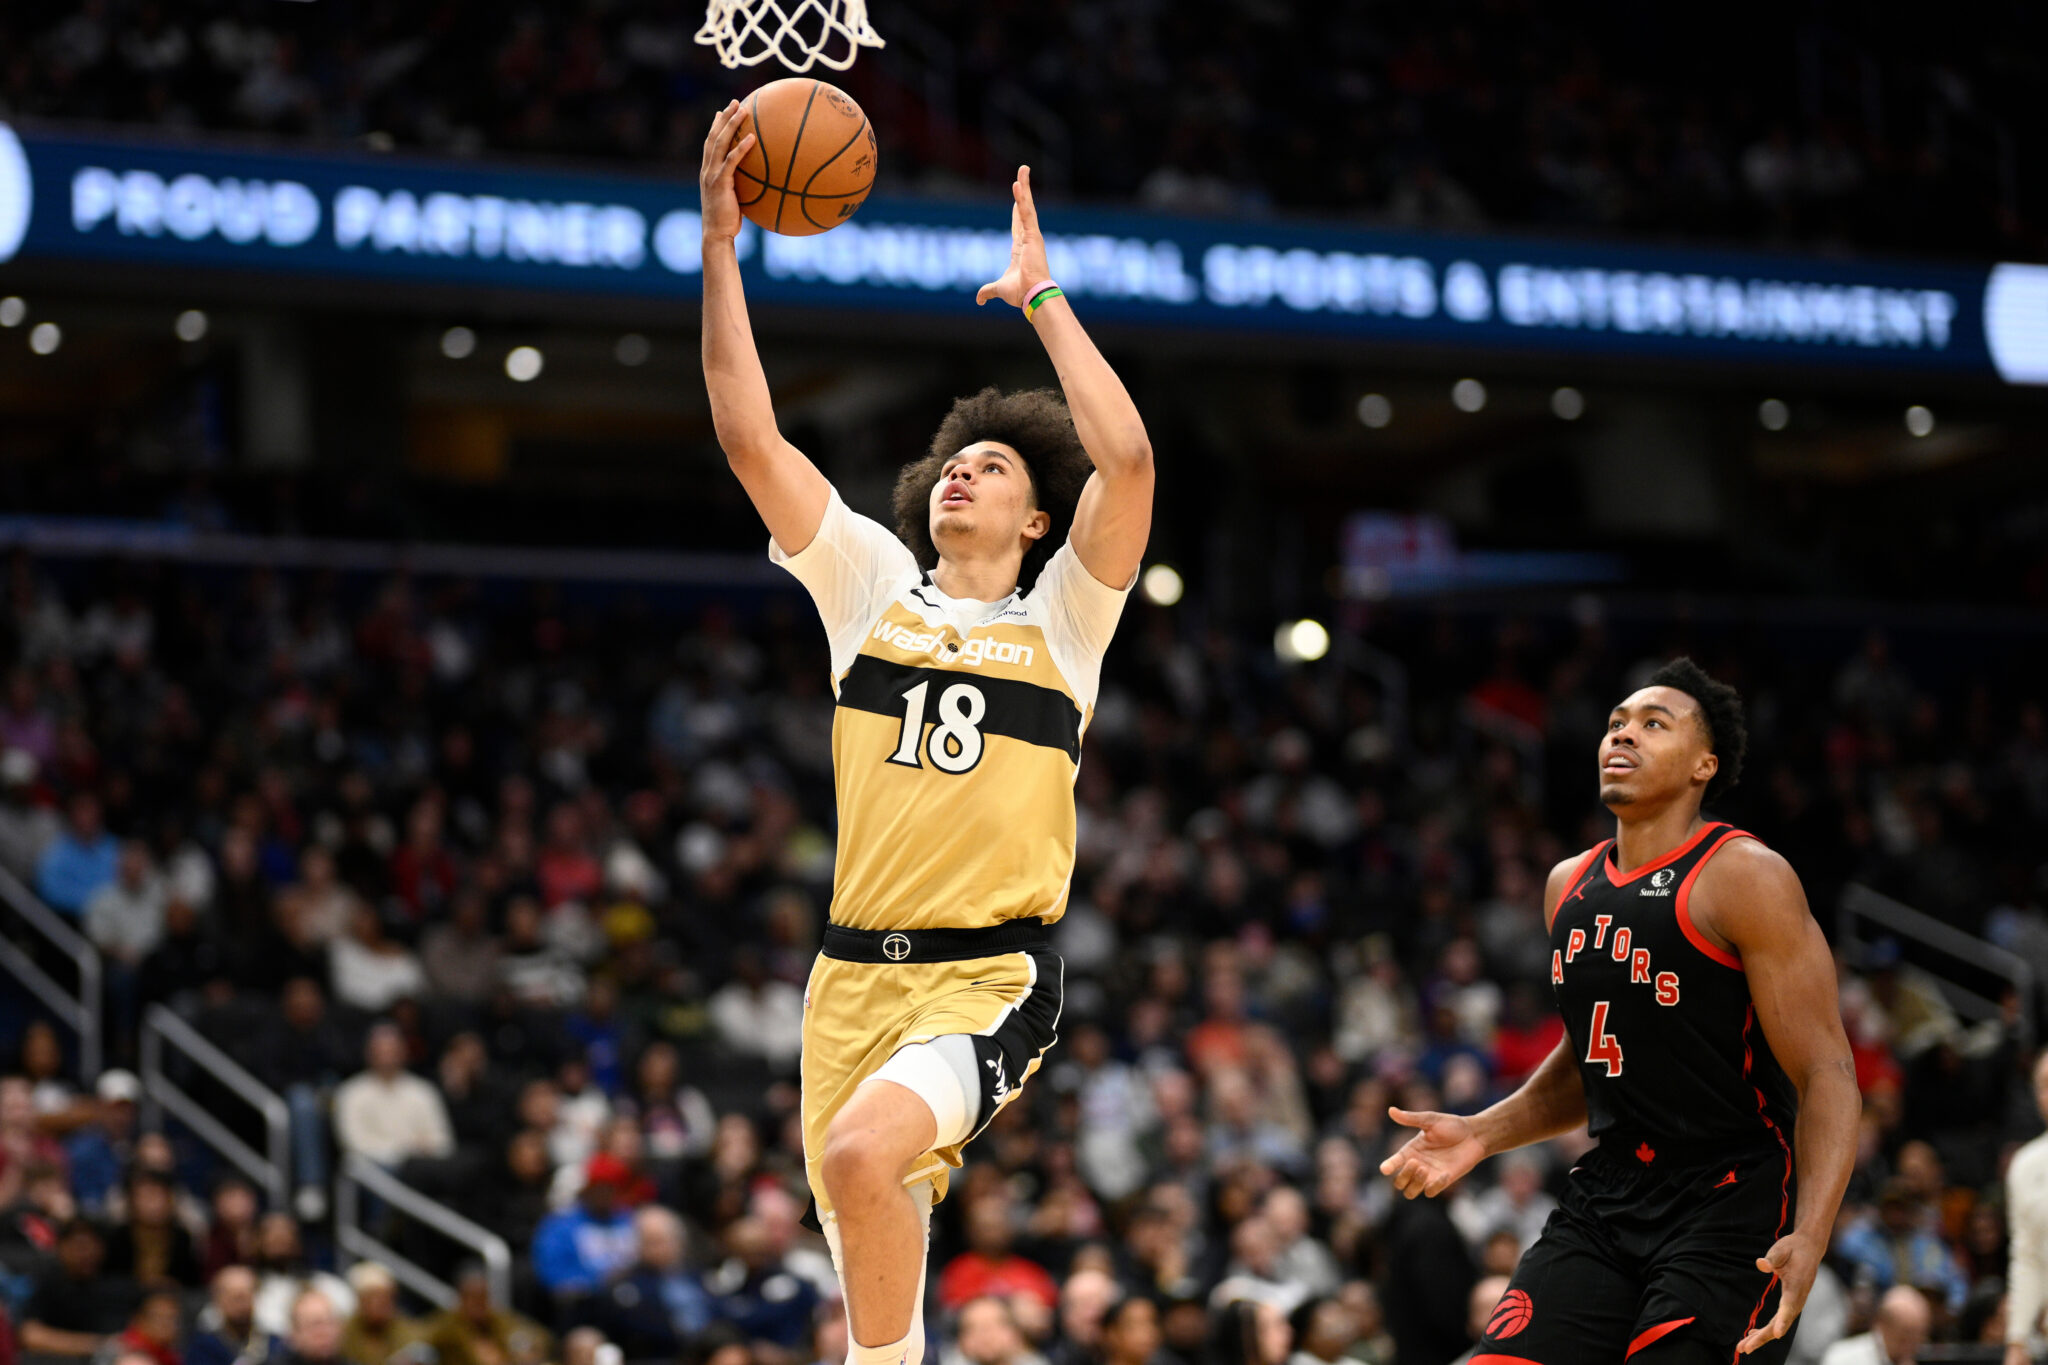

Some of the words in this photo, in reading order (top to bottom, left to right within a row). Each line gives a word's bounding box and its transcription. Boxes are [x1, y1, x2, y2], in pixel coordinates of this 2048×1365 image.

[71, 167, 320, 245] PROUD
[333, 186, 646, 268] PARTNER
[653, 209, 753, 273] O
[764, 222, 1197, 303] MONUMNTAL
[1204, 245, 1437, 317] SPORTS
[1445, 262, 1491, 320] &
[1498, 264, 1955, 346] ENTERTAINMENT
[885, 679, 986, 775] 18
[1639, 887, 1655, 897] Sun
[1655, 887, 1671, 897] Life
[1552, 914, 1680, 1007] APTORS
[1585, 1001, 1624, 1078] 4
